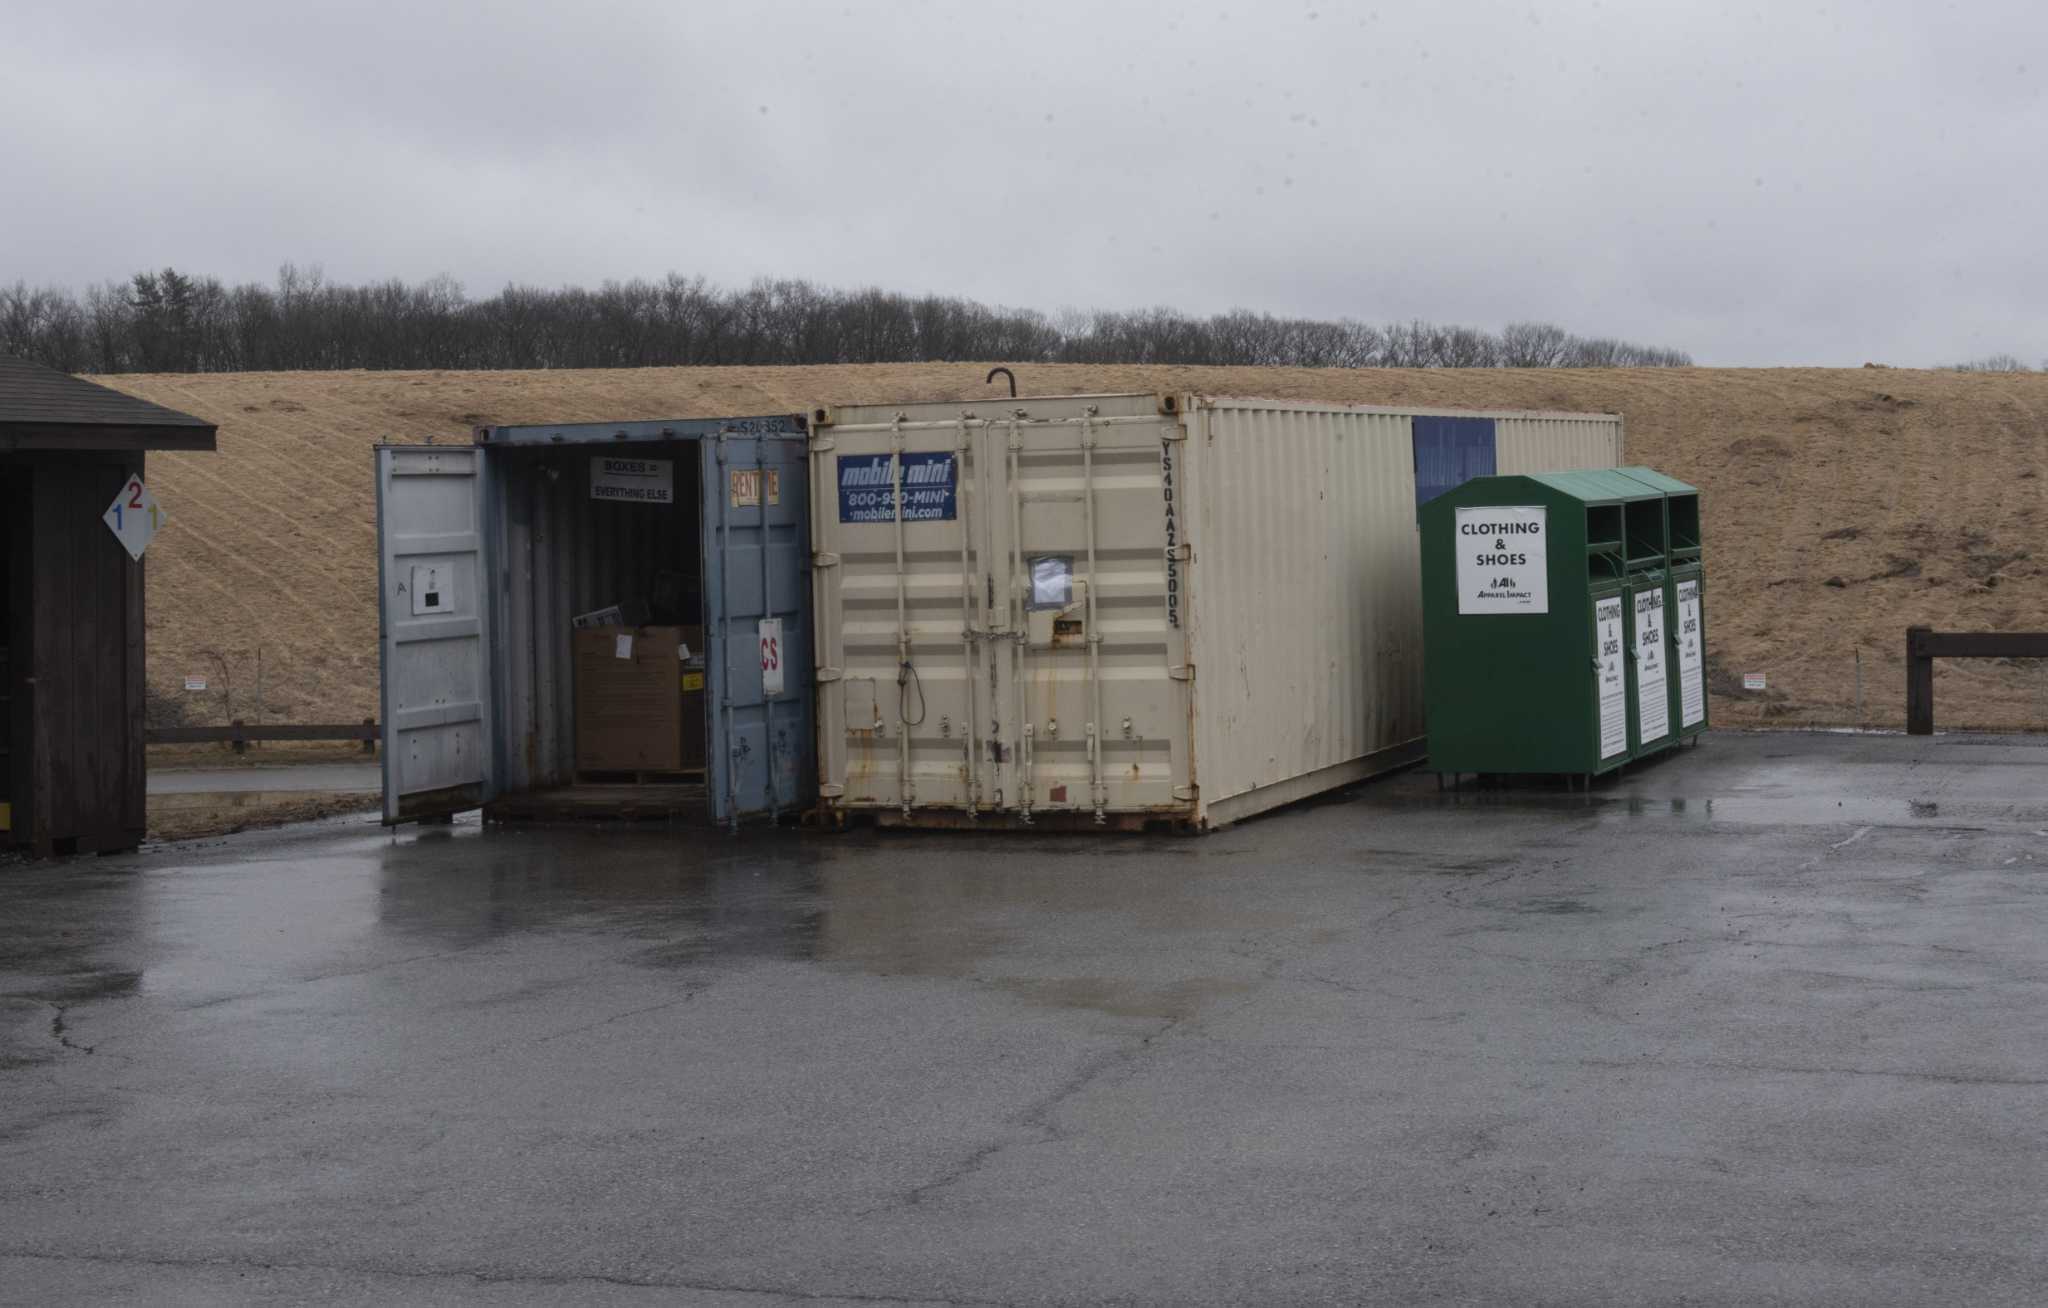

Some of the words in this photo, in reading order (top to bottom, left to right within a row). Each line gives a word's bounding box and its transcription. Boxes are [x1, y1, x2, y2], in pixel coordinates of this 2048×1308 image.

[603, 460, 645, 472] BOXES
[906, 458, 952, 483] mini
[127, 481, 144, 509] 2
[595, 486, 645, 498] EVERYTHING
[647, 488, 669, 500] ELSE
[112, 503, 123, 531] 1
[147, 503, 158, 530] 1
[1461, 522, 1540, 535] CLOTHING
[1495, 538, 1507, 550] &
[1476, 553, 1527, 566] SHOES
[761, 637, 778, 671] CS
